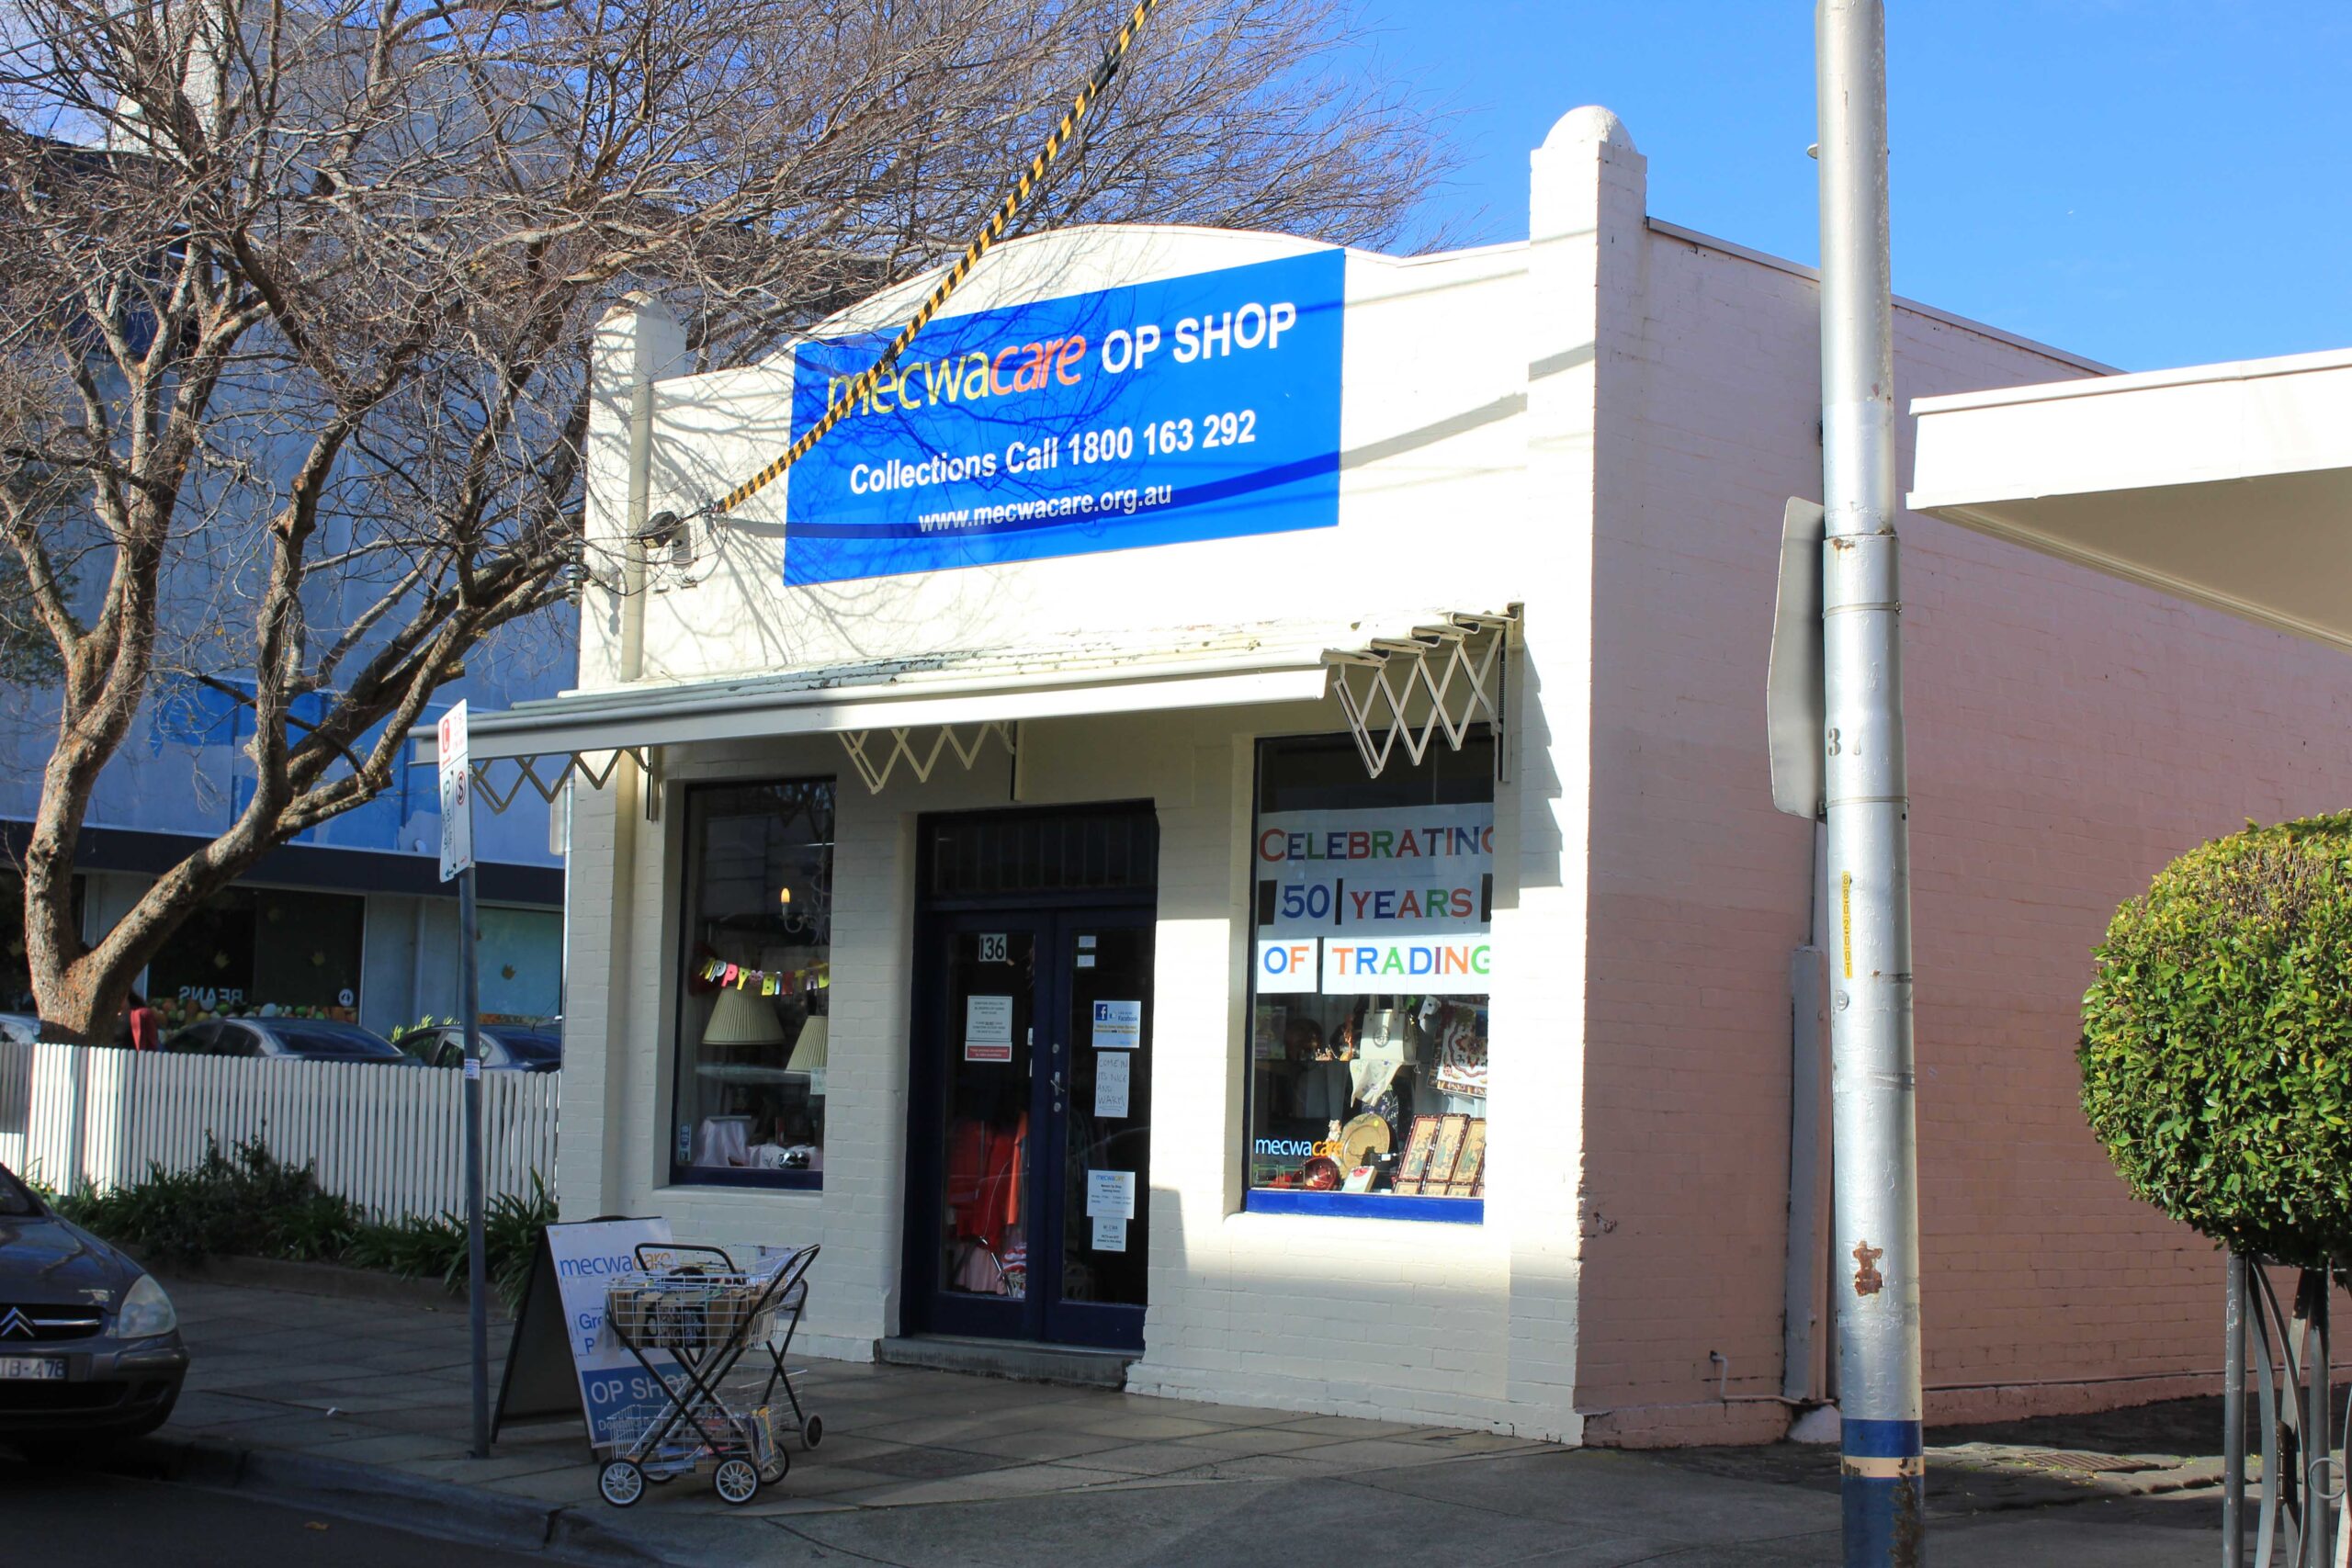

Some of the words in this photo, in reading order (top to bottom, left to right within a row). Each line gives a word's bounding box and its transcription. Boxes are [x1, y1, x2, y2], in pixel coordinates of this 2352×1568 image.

[828, 333, 1087, 418] mecwacare
[1102, 324, 1160, 373] OP
[1173, 302, 1296, 365] SHOP
[850, 451, 997, 494] Collections
[1006, 437, 1058, 475] Call
[1069, 431, 1134, 465] 1800
[1143, 422, 1193, 457] 163
[1203, 410, 1256, 449] 292
[919, 484, 1172, 533] www.mecwacare.org.au
[1281, 884, 1330, 919] 50
[1350, 888, 1474, 919] YEARS
[979, 937, 1005, 960] 136
[1263, 945, 1310, 975] OF
[1332, 944, 1490, 975] TRADING
[1255, 1138, 1344, 1156] mecwacare
[591, 1380, 624, 1404] OP
